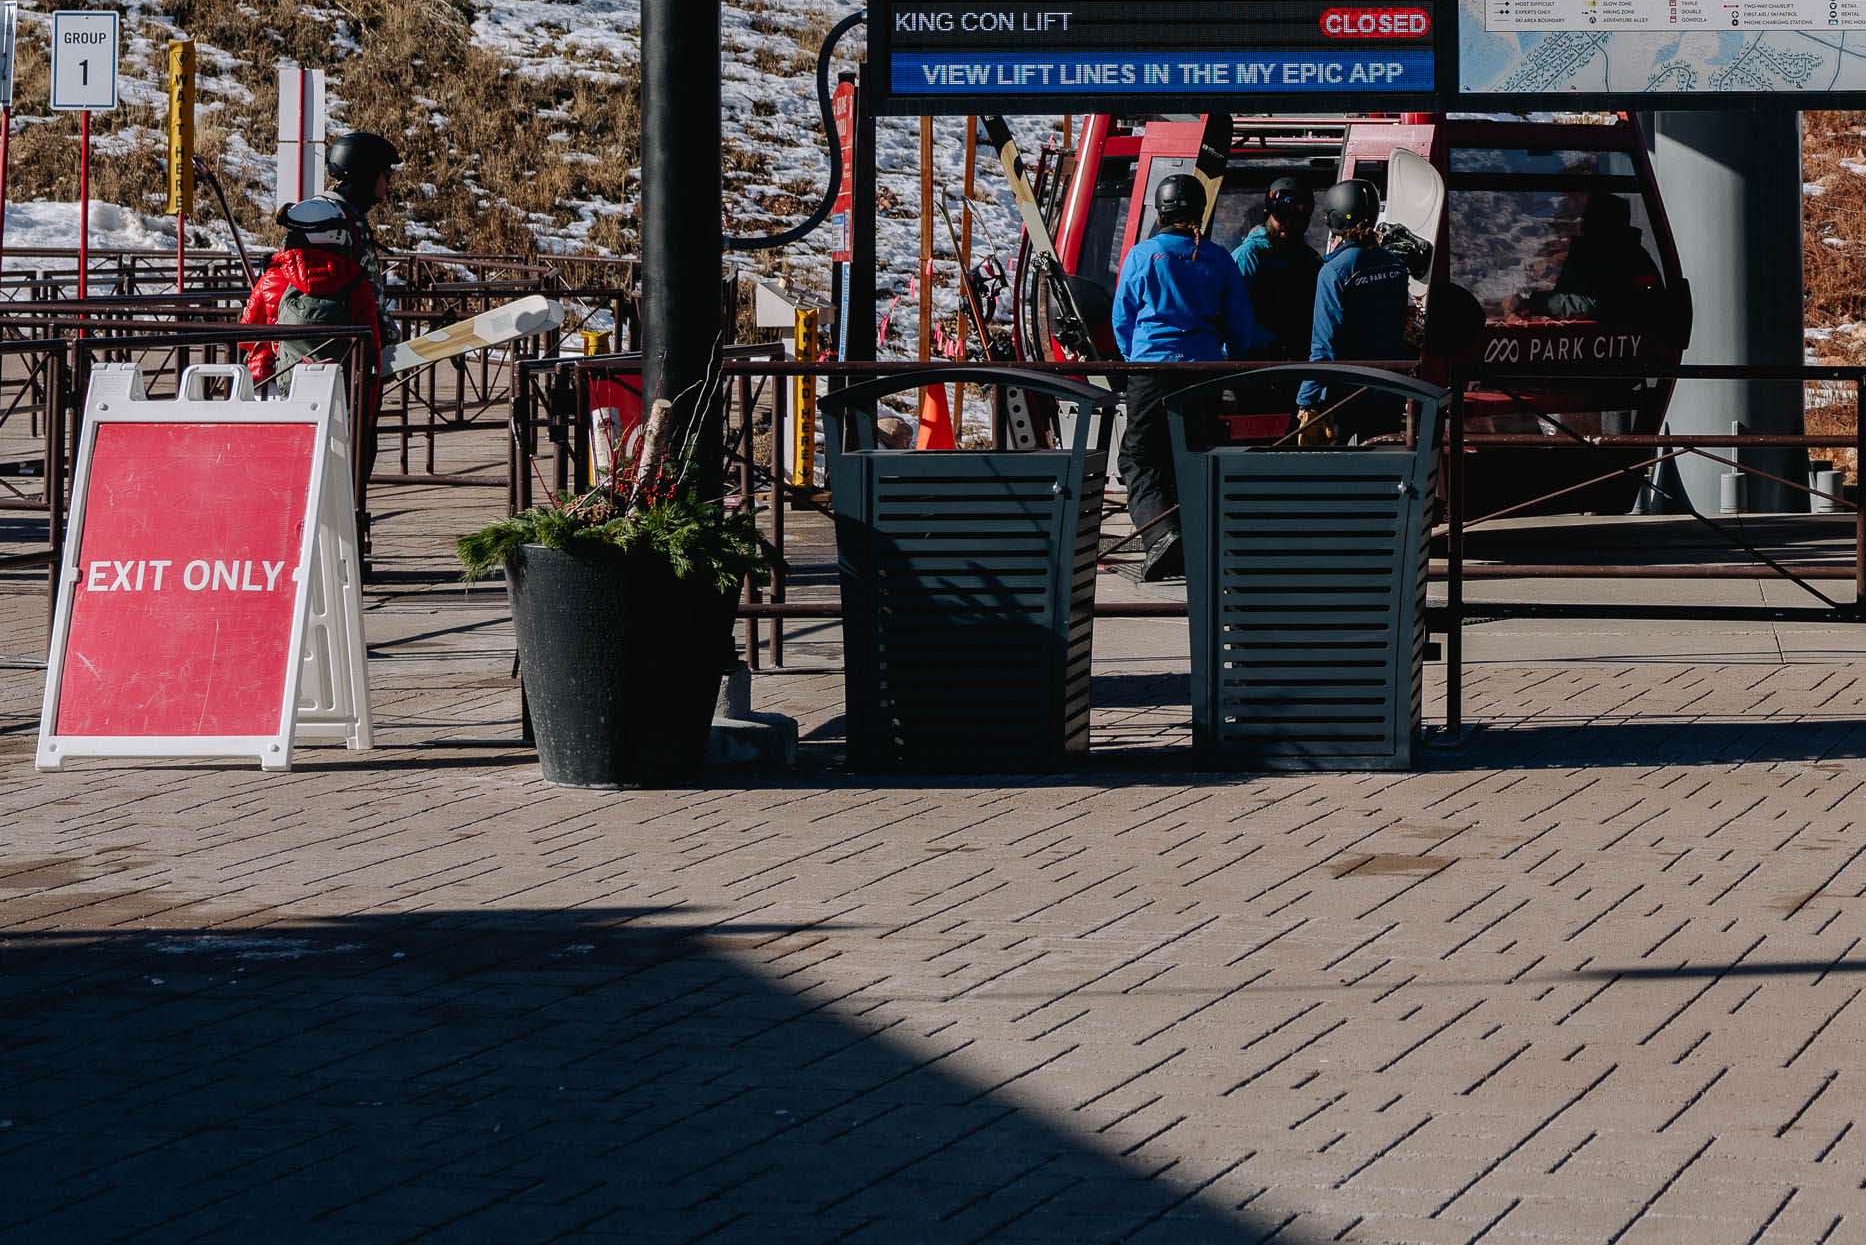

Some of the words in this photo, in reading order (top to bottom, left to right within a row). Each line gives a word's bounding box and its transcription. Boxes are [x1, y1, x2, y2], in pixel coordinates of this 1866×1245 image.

[896, 13, 953, 32] KING
[961, 13, 1014, 32] CON
[1023, 13, 1072, 32] LIFT
[1326, 15, 1426, 34] CLOSED
[64, 32, 107, 45] GROUP
[79, 59, 88, 86] 1
[923, 64, 991, 85] VIEW
[997, 64, 1053, 85] LIFT
[1060, 64, 1135, 85] LINES
[1144, 64, 1169, 85] IN
[1178, 64, 1230, 85] THE
[1236, 64, 1276, 85] MY
[1282, 64, 1343, 85] EPIC
[1349, 64, 1403, 85] APP
[175, 74, 188, 136] WAIT
[174, 145, 185, 209] HERE
[1529, 336, 1585, 361] PARK
[1593, 335, 1642, 358] CITY
[87, 560, 172, 592] EXIT
[183, 559, 286, 592] ONLY
